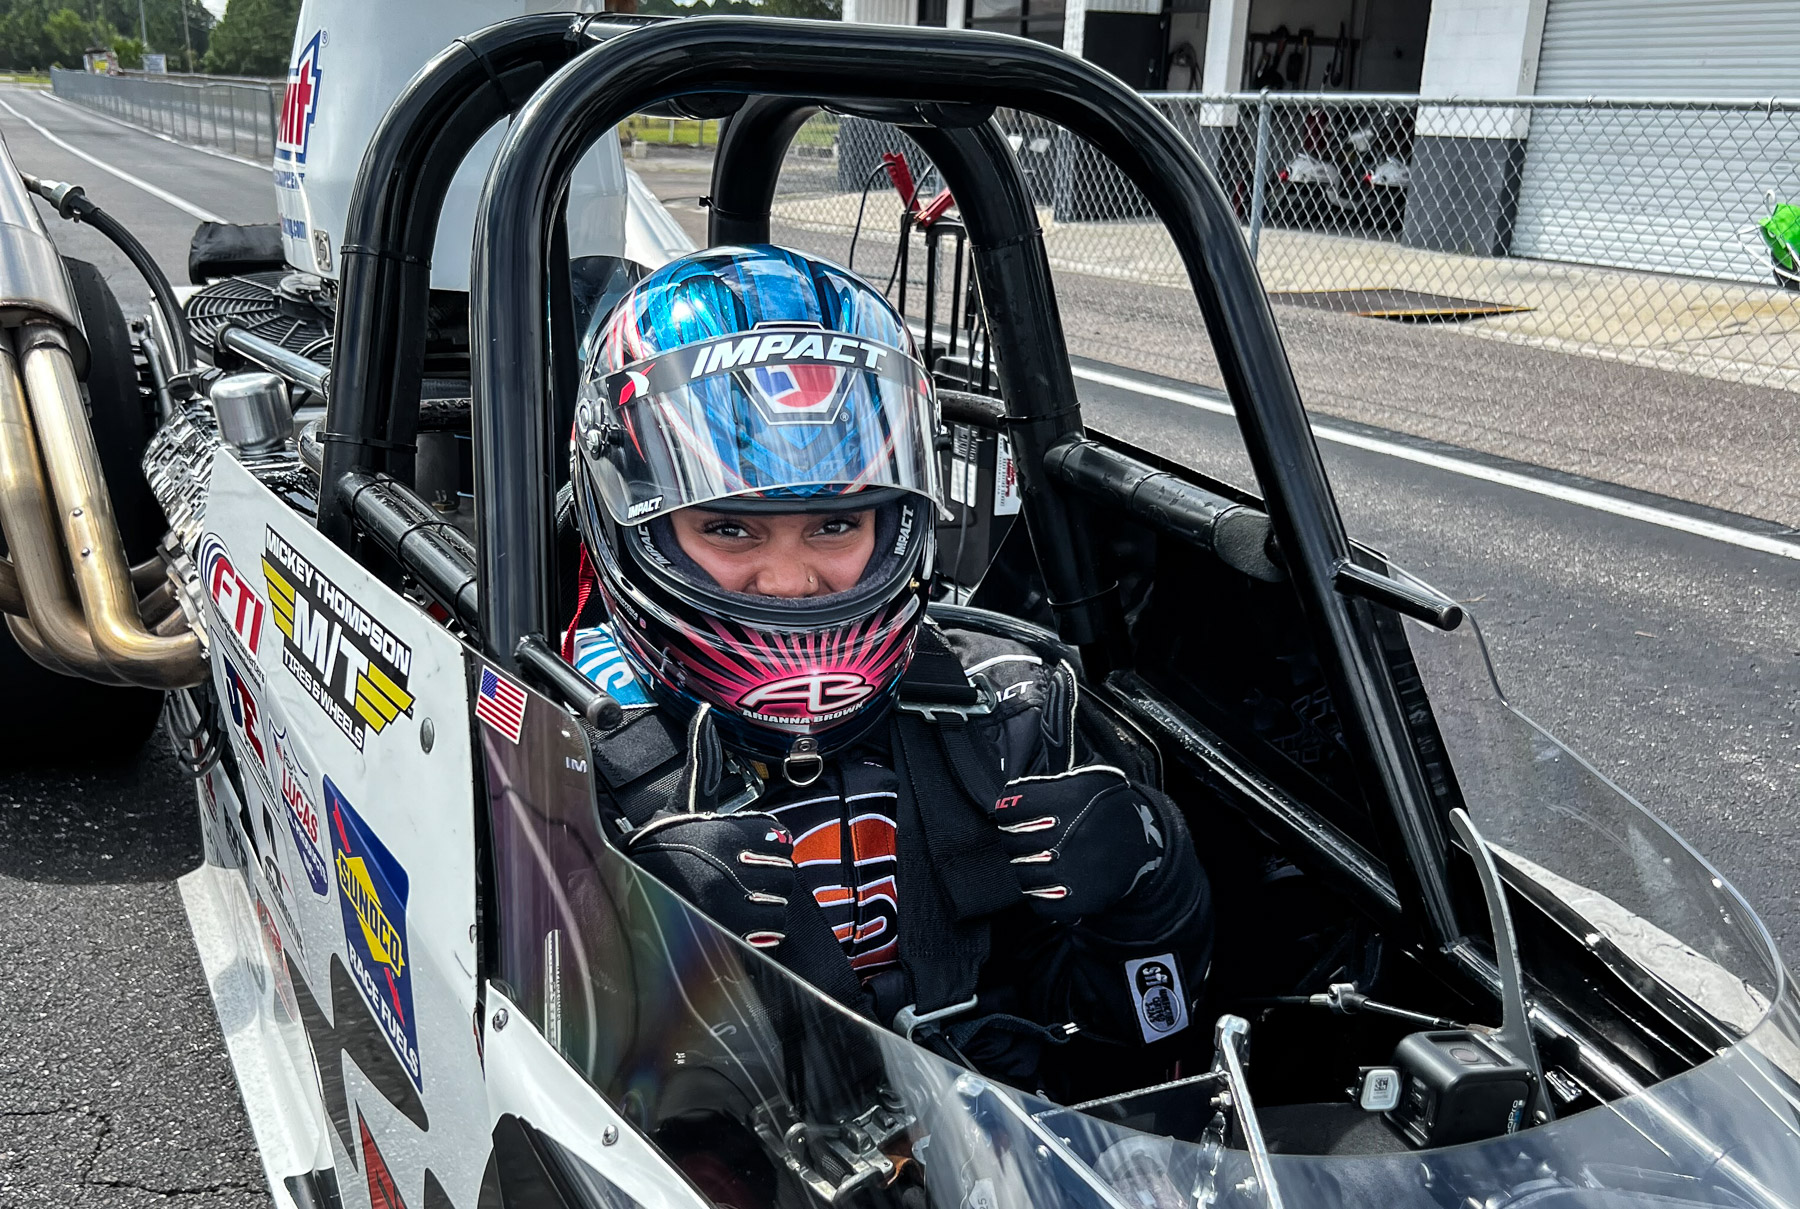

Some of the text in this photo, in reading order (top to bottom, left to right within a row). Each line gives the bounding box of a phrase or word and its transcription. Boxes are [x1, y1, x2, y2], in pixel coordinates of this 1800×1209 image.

[690, 334, 888, 379] IMPACT
[627, 496, 662, 518] IMPACT
[893, 505, 914, 556] IMPACT
[637, 524, 672, 565] IMPAC
[211, 556, 265, 657] FTI
[265, 527, 317, 588] MICKEY
[315, 572, 413, 677] THOMPSON
[283, 646, 365, 748] TIRES & WHEELS
[741, 673, 875, 712] AB
[742, 701, 864, 725] ARIANNA BROWN
[282, 768, 318, 844] LUCAS
[338, 857, 401, 970] SUNOCO
[348, 939, 420, 1078] RACE FUELS
